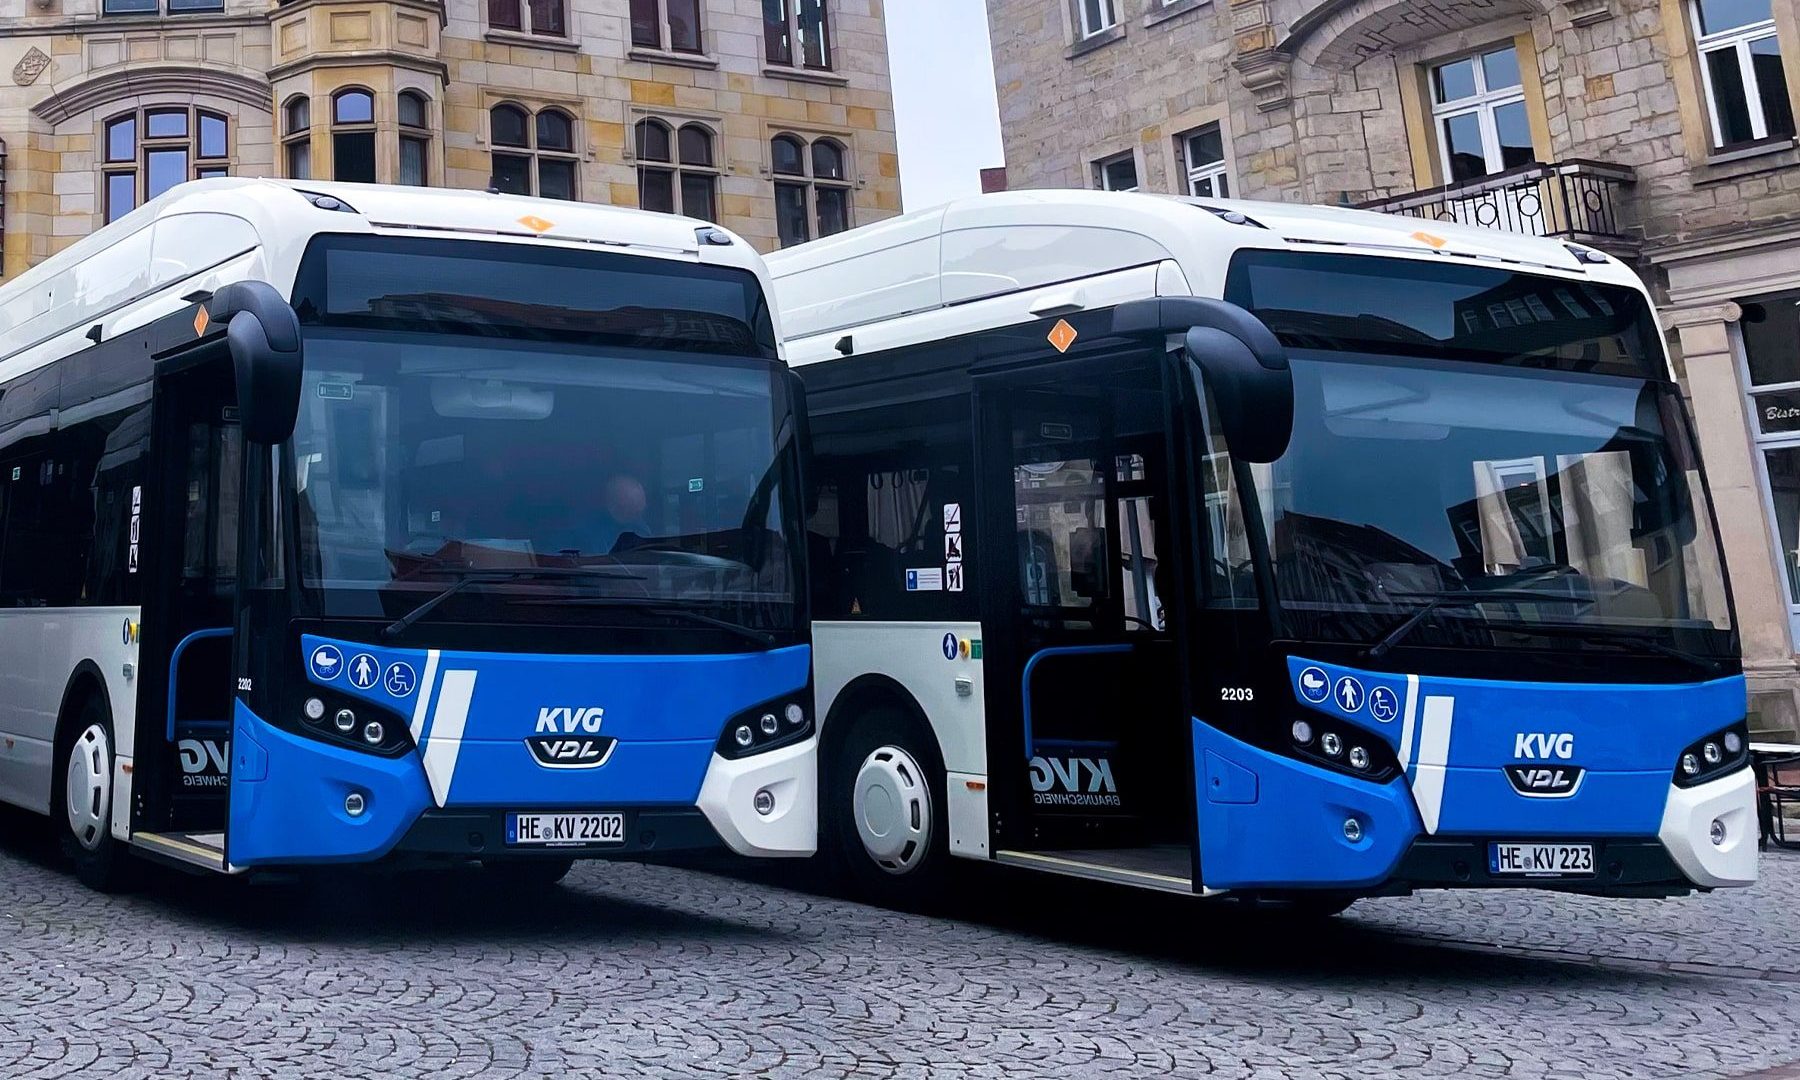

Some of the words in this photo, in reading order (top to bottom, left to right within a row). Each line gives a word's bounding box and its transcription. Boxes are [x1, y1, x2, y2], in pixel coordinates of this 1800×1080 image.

[1766, 406, 1800, 420] Bistr
[237, 677, 252, 691] 2202
[1221, 687, 1254, 701] 2203
[535, 707, 604, 733] KVG
[540, 741, 600, 759] VDL
[1514, 733, 1574, 759] KVG
[1516, 769, 1570, 788] VDL
[519, 817, 541, 839] HE
[554, 817, 576, 839] KV
[580, 816, 621, 839] 2202
[1499, 847, 1522, 869] HE
[1533, 847, 1555, 869] KV
[1560, 847, 1591, 869] 223
